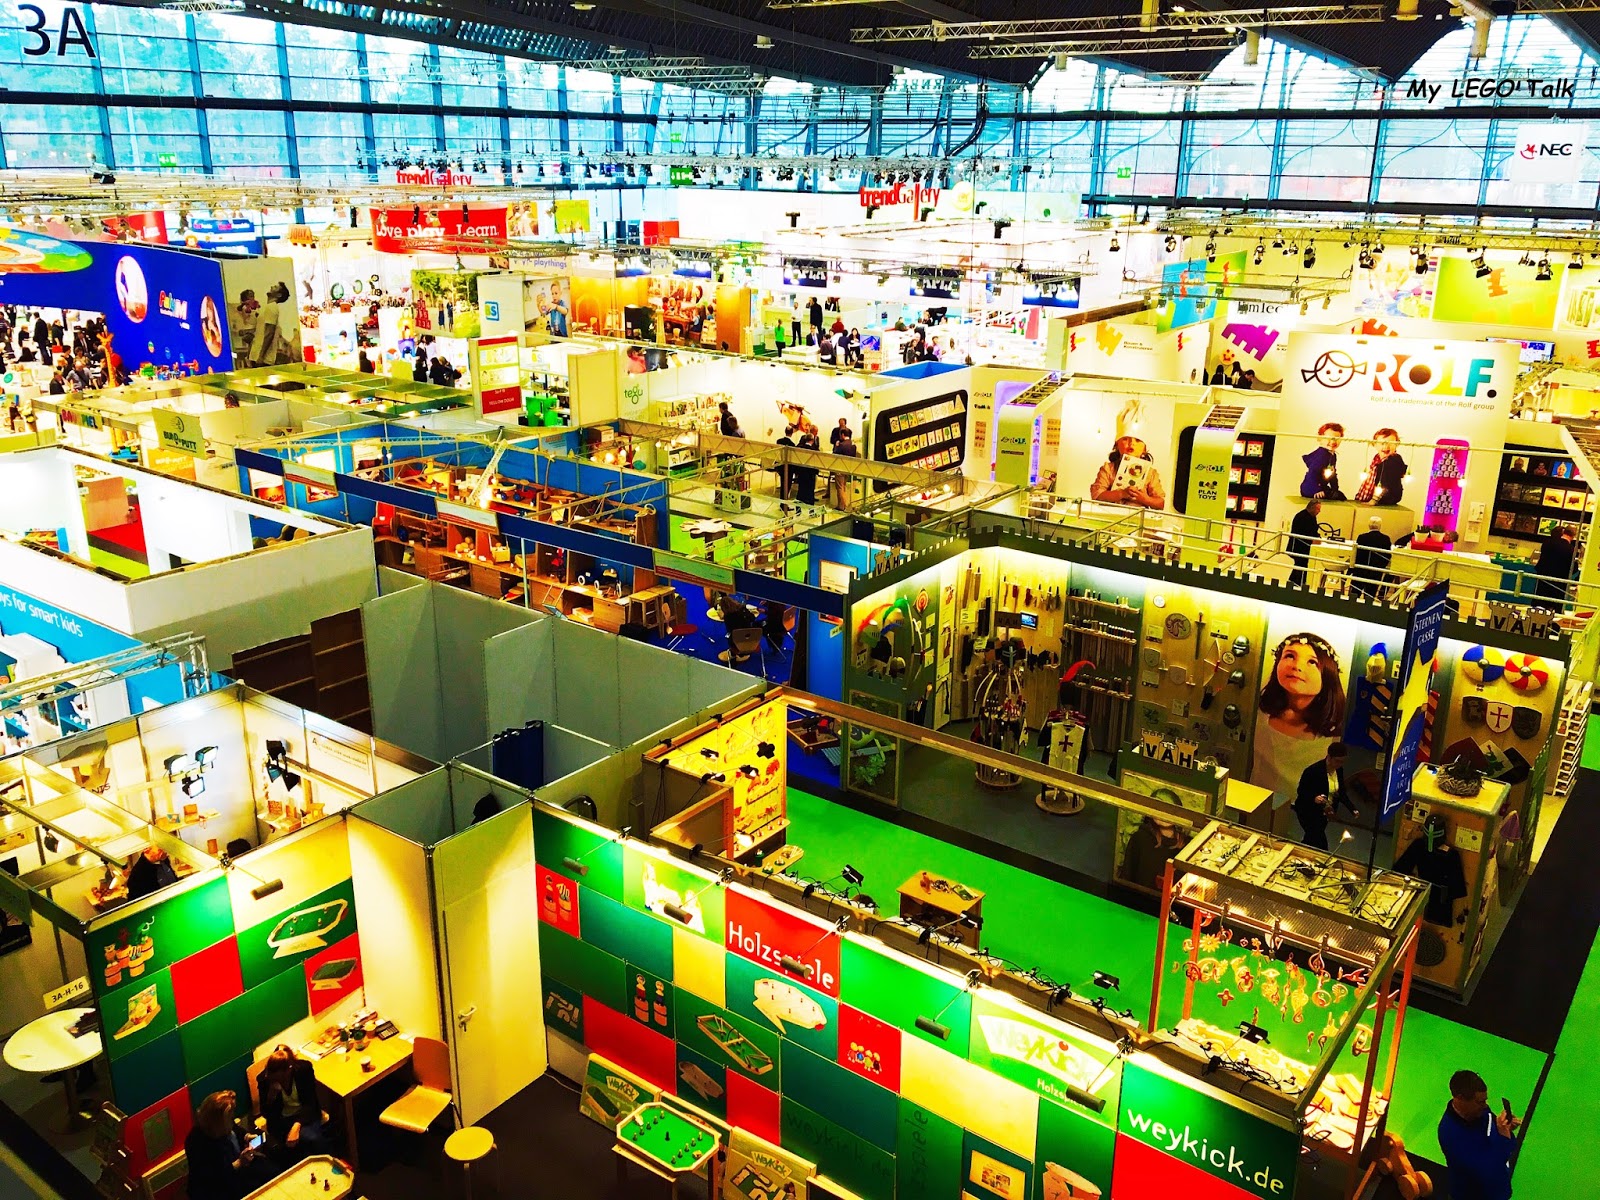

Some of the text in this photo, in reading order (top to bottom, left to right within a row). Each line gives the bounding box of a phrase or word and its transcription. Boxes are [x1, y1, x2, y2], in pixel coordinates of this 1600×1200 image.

[17, 4, 96, 58] 3A
[376, 224, 403, 238] Love
[534, 258, 567, 270] playthings
[624, 384, 643, 404] tegu
[877, 555, 899, 574] VAH
[12, 593, 27, 613] for
[28, 604, 60, 628] smart
[60, 613, 83, 638] kids
[1414, 611, 1442, 632] STERNEN
[1493, 615, 1546, 638] VAH
[1417, 628, 1436, 647] GASSE
[1145, 742, 1193, 768] VAH
[728, 920, 835, 990] Holzsele
[51, 981, 84, 1003] 3A-H-16
[1127, 1108, 1285, 1195] weykick.de
